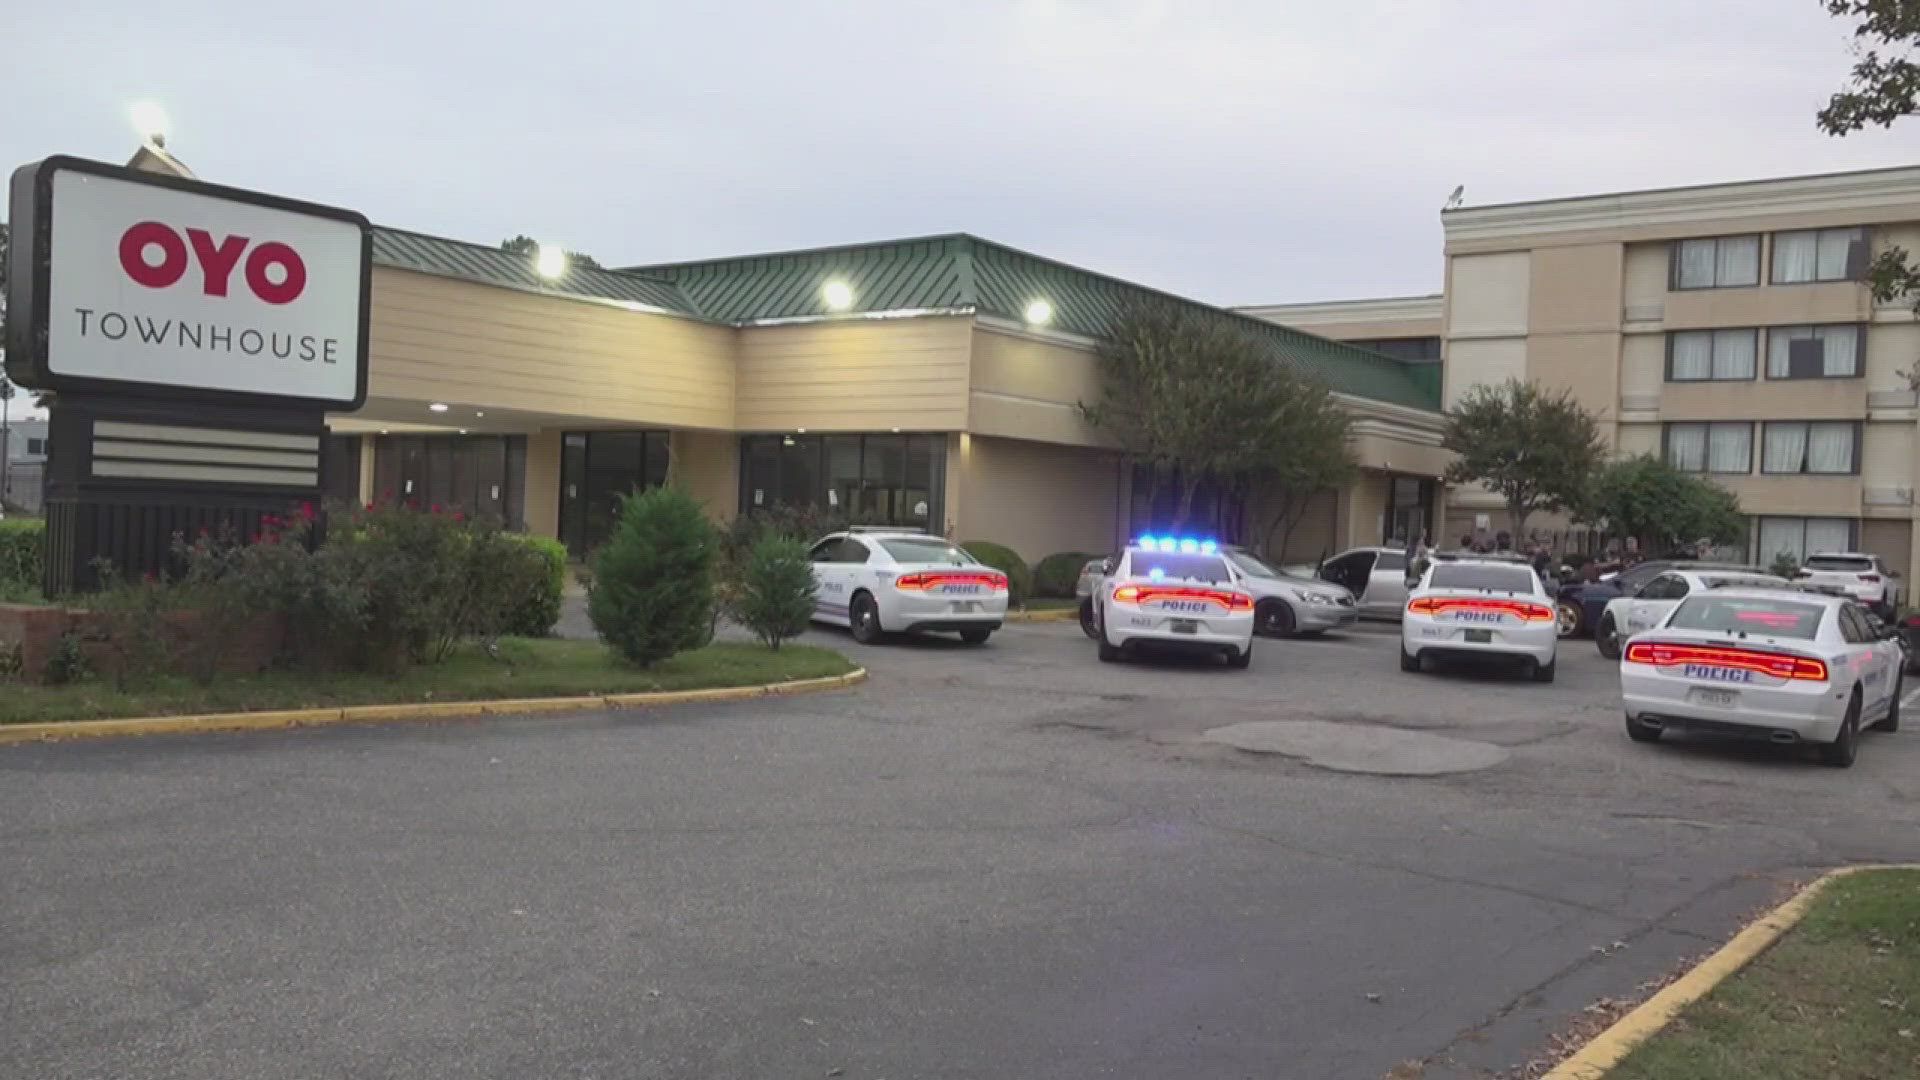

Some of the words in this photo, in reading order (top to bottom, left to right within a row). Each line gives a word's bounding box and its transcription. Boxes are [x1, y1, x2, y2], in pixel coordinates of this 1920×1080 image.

[119, 221, 306, 305] OYO
[75, 308, 338, 364] TOWNHOUSE
[942, 584, 981, 594] POLICE
[1161, 600, 1207, 613] POLICE
[1454, 611, 1504, 623] POLICE
[1684, 663, 1754, 683] POLICE
